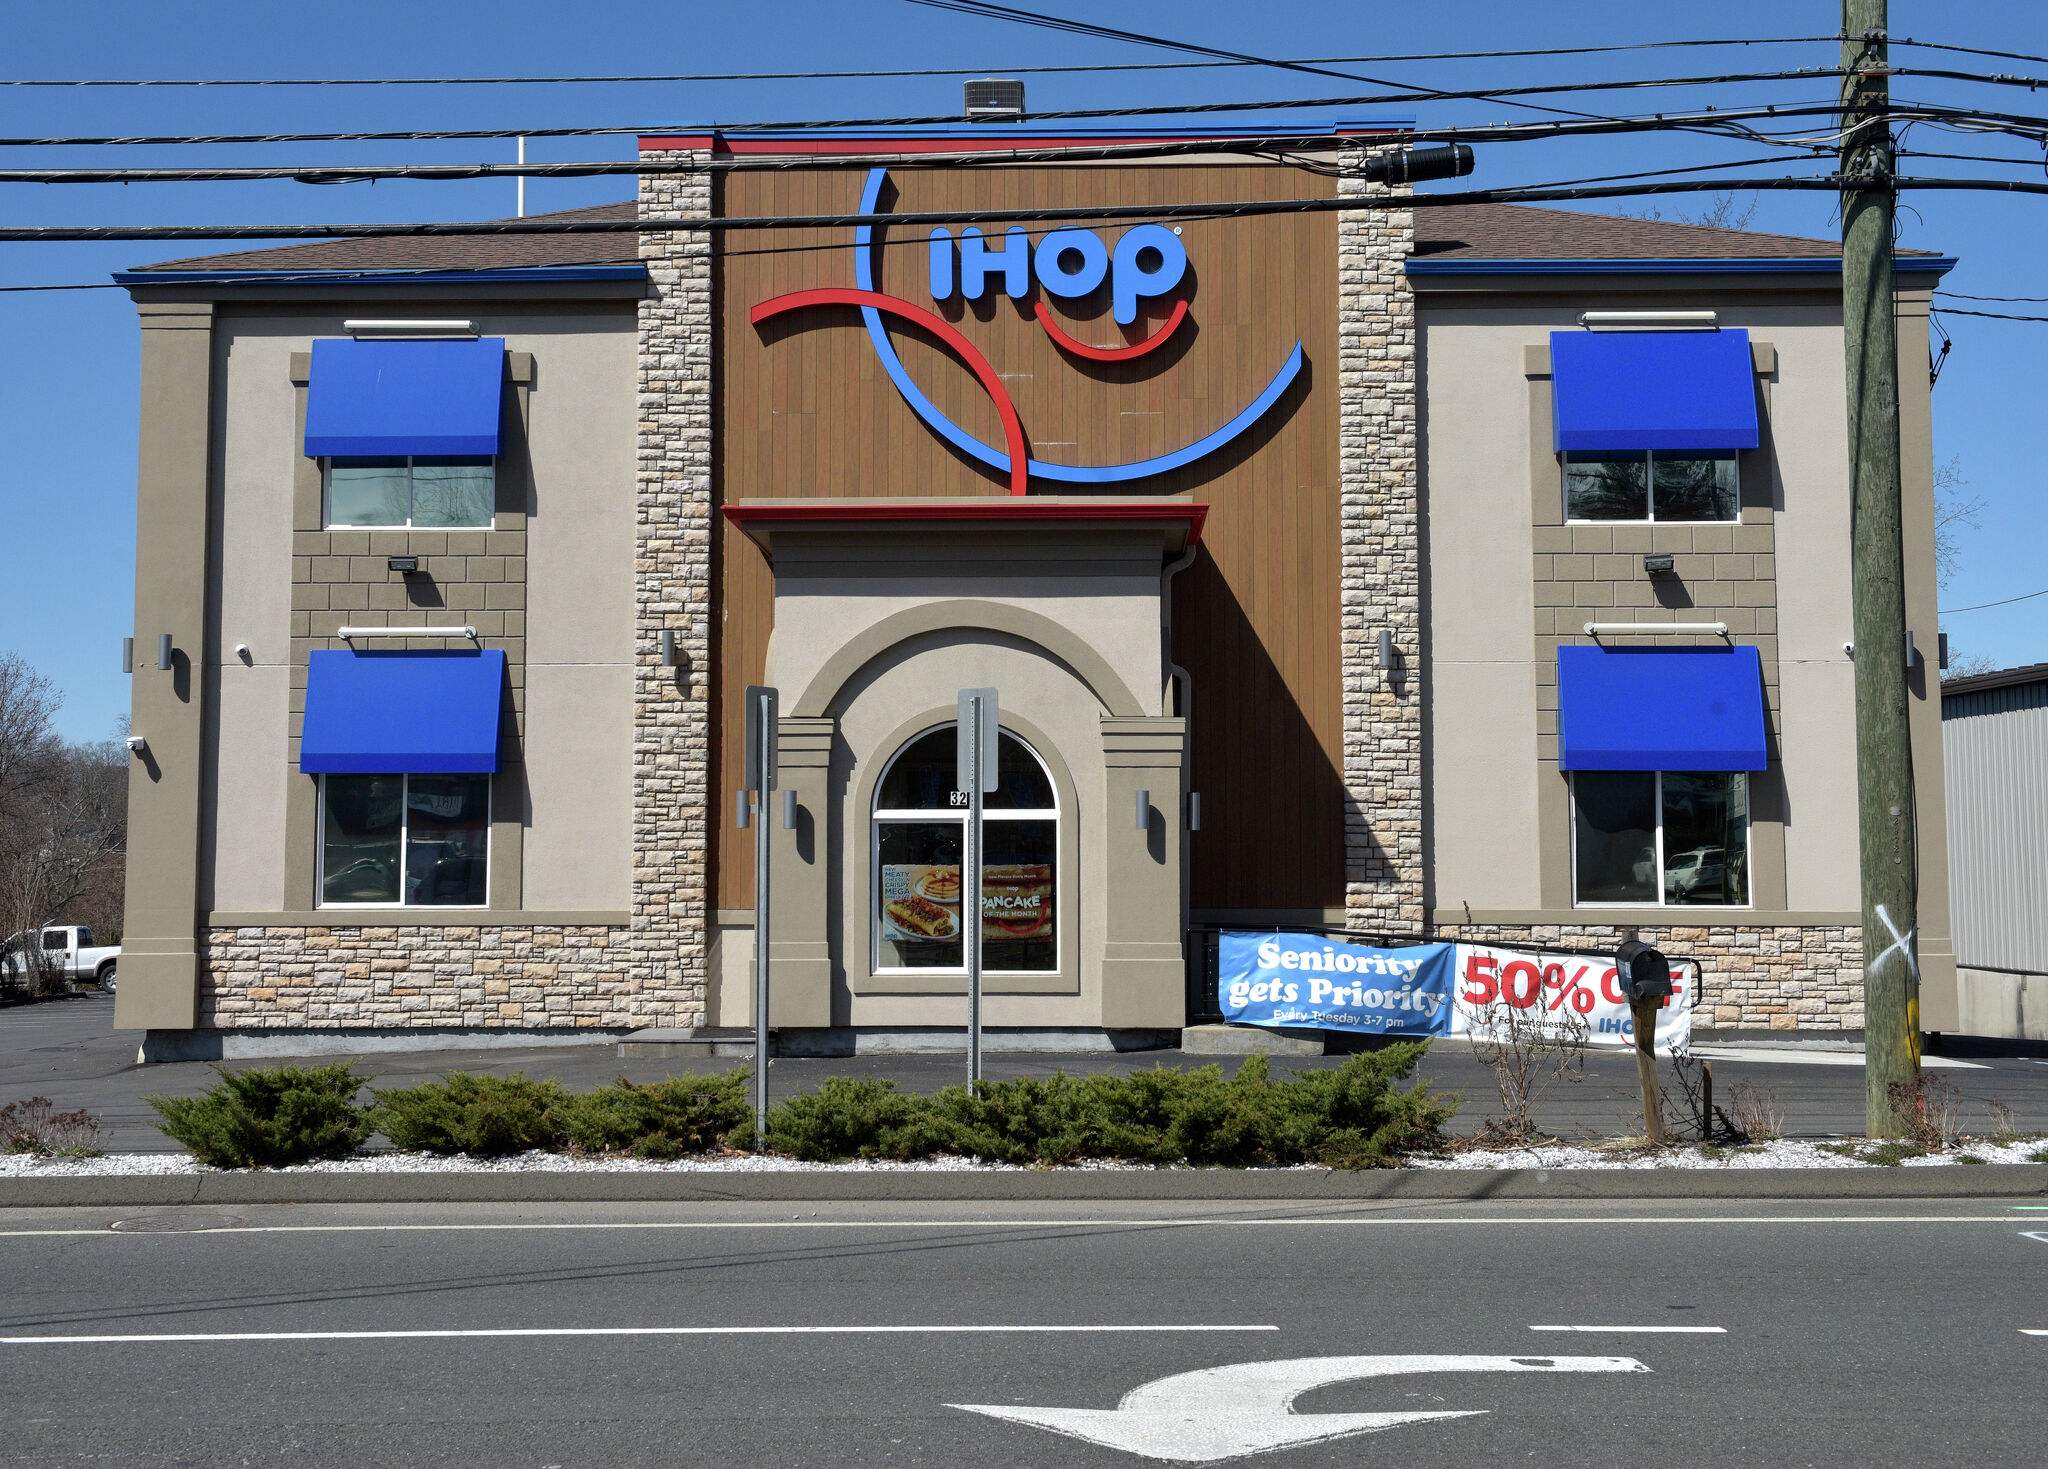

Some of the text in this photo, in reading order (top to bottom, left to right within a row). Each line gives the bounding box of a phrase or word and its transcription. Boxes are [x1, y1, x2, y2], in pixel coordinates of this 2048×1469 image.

[929, 224, 1187, 325] IHOP
[951, 792, 967, 805] 32
[982, 895, 1041, 909] PANCAKE
[1257, 943, 1423, 982] Seniority
[1229, 978, 1445, 1018] gets Priority
[1463, 956, 1596, 1014] 50%
[1273, 1010, 1404, 1028] Every Tuesday 3-7 pm
[1599, 1018, 1635, 1035] IHO
